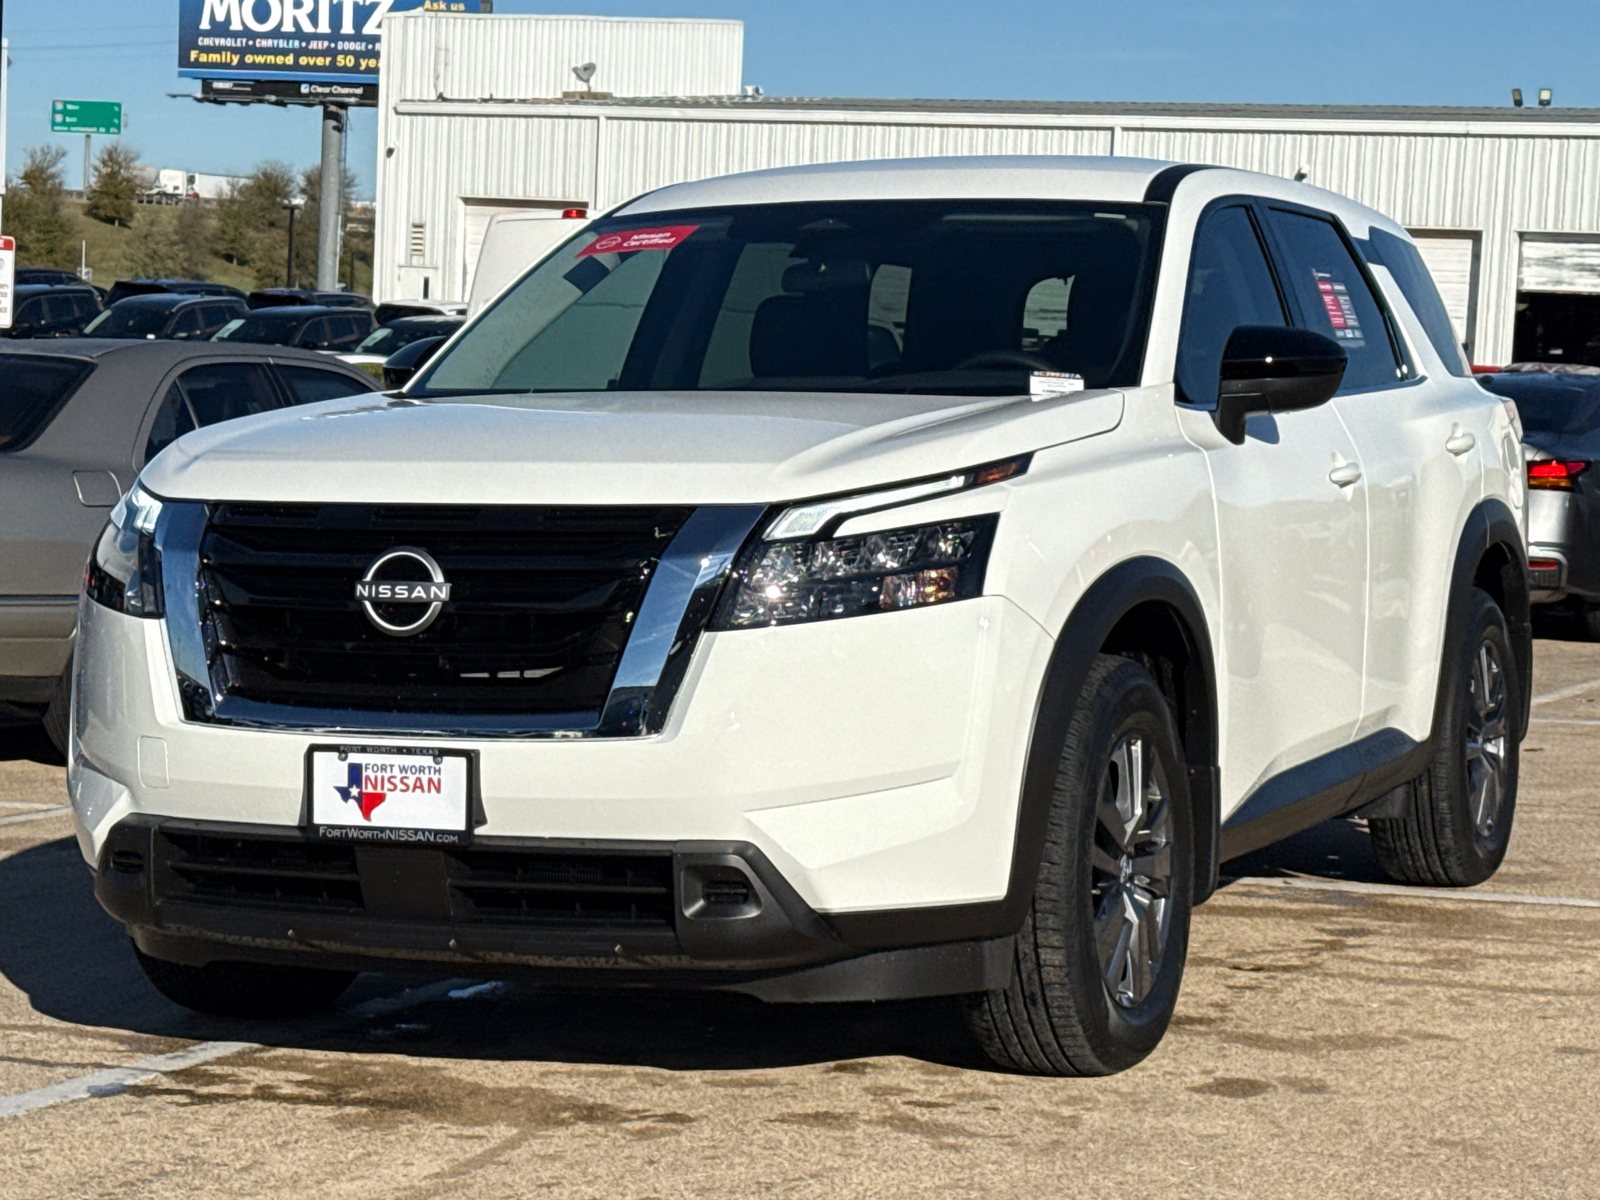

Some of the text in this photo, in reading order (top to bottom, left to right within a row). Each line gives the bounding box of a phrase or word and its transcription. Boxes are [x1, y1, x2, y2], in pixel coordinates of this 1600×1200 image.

[423, 0, 466, 11] Ask us
[199, 0, 395, 35] MORITZ
[198, 36, 247, 48] CHEVROLET
[255, 37, 300, 49] CHRYSLER
[308, 40, 329, 49] JEEP
[337, 41, 367, 51] DODGE
[190, 50, 240, 66] Family
[244, 53, 294, 66] owned
[298, 55, 332, 67] over
[336, 54, 355, 67] 50
[310, 84, 363, 95] Clear Channel
[356, 584, 447, 599] NISSAN
[339, 745, 439, 756] FORT WORTH TEXAS
[364, 763, 442, 776] FORT WORTH
[364, 775, 442, 795] NISSAN
